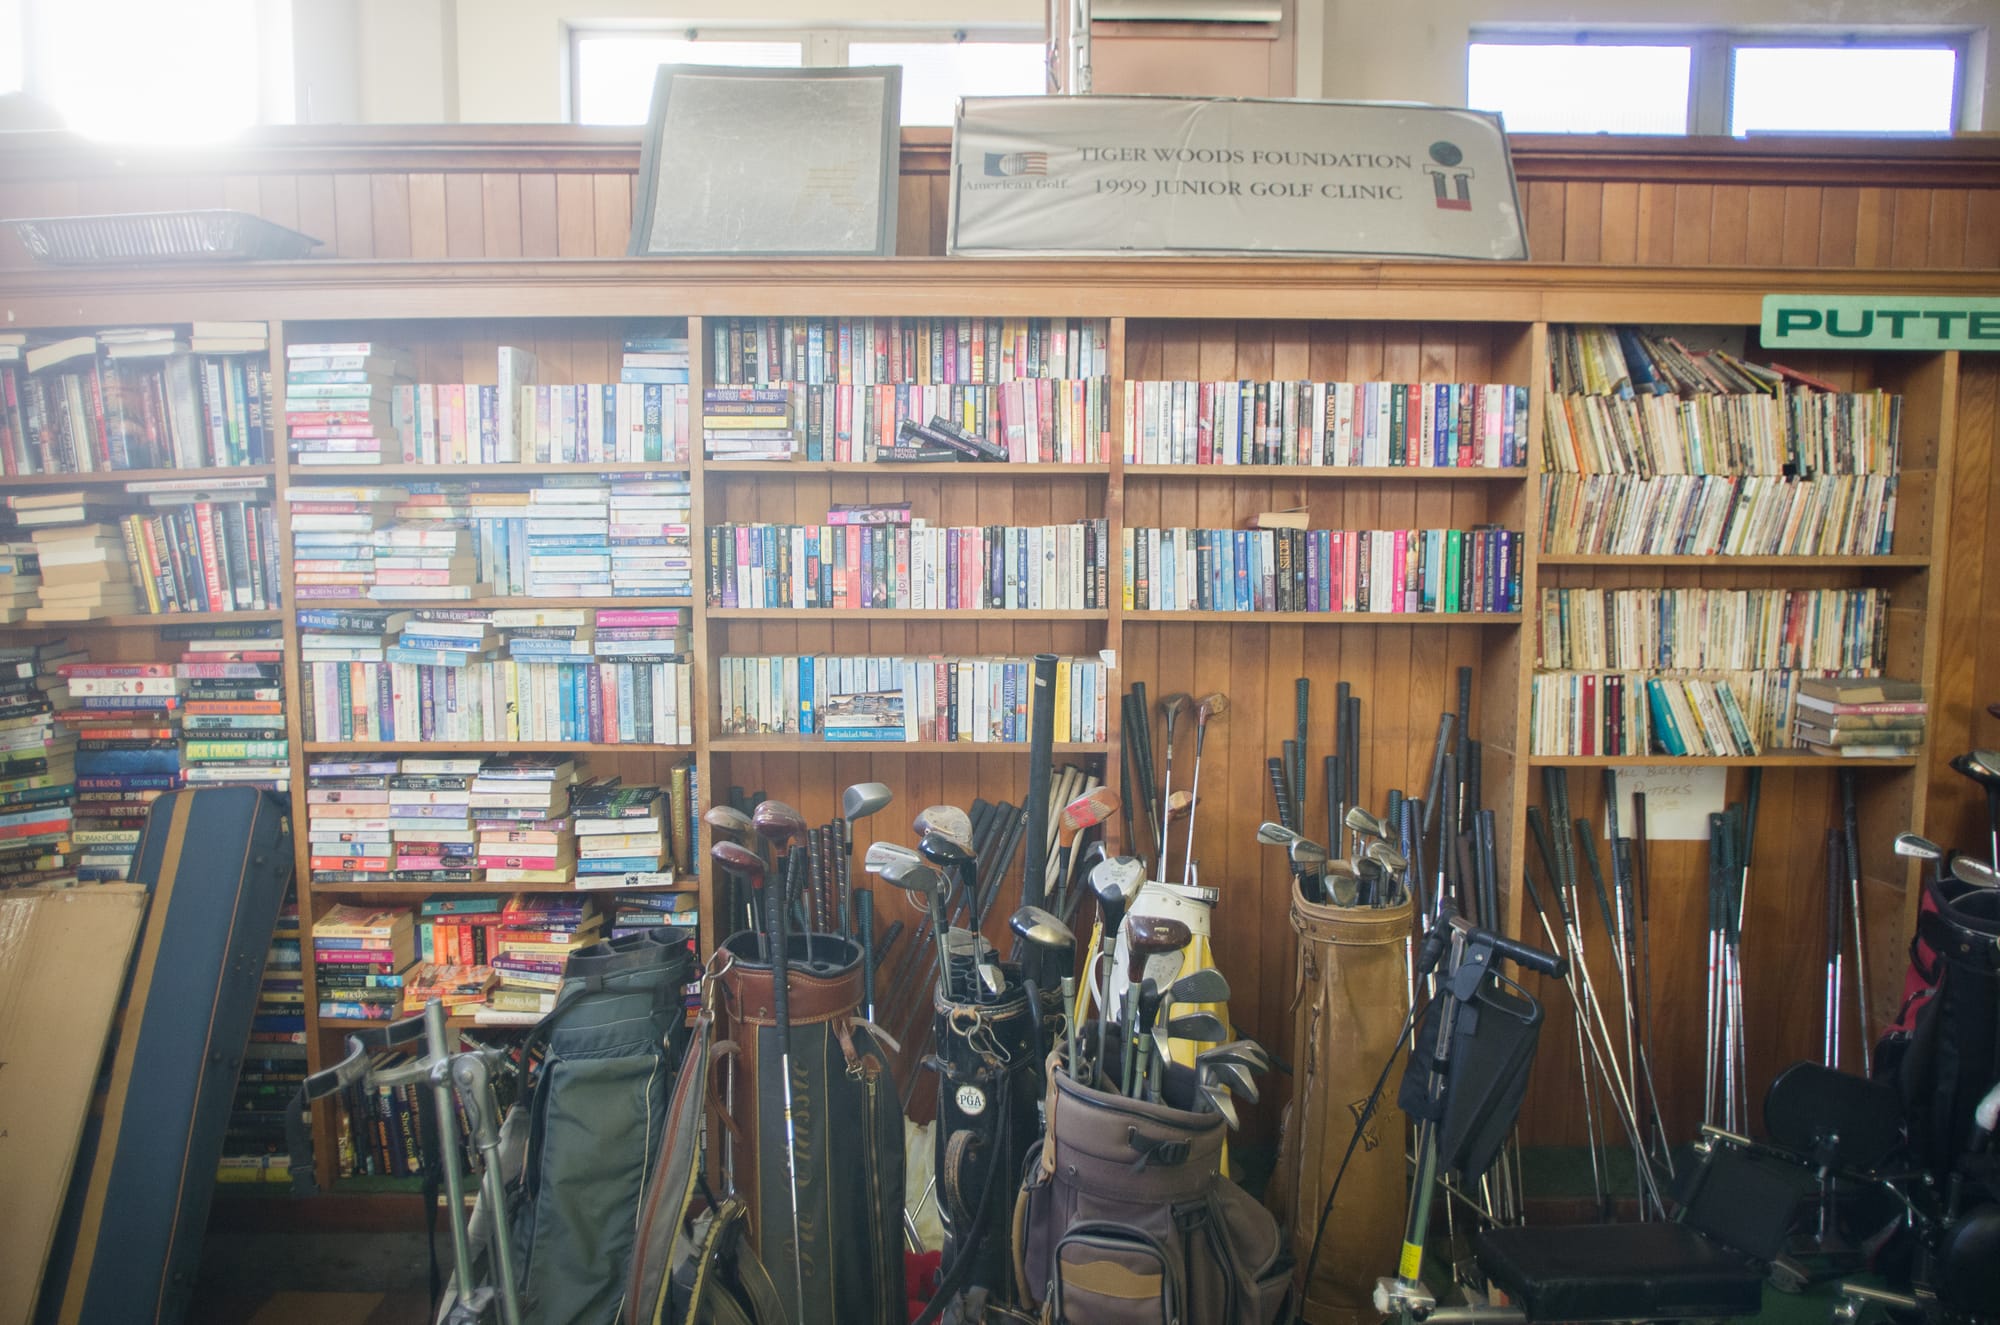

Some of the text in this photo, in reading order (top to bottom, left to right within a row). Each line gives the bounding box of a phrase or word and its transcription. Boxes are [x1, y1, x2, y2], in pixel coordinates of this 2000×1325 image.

[1079, 146, 1412, 170] TIGER WOODS FOUNDATION
[964, 178, 1067, 191] American Golf
[1094, 178, 1404, 201] 1999 JUNIOR GOLF CLINIC
[913, 541, 922, 607] SANDRA BROWN
[351, 617, 374, 630] THE LIAR
[183, 730, 249, 740] NICHOLAS SPARKS
[187, 743, 208, 757] DICK
[209, 743, 246, 757] FRANCIS
[75, 832, 135, 843] ROMAN CIRCUS
[959, 1094, 982, 1107] PGA
[400, 1111, 411, 1136] Short
